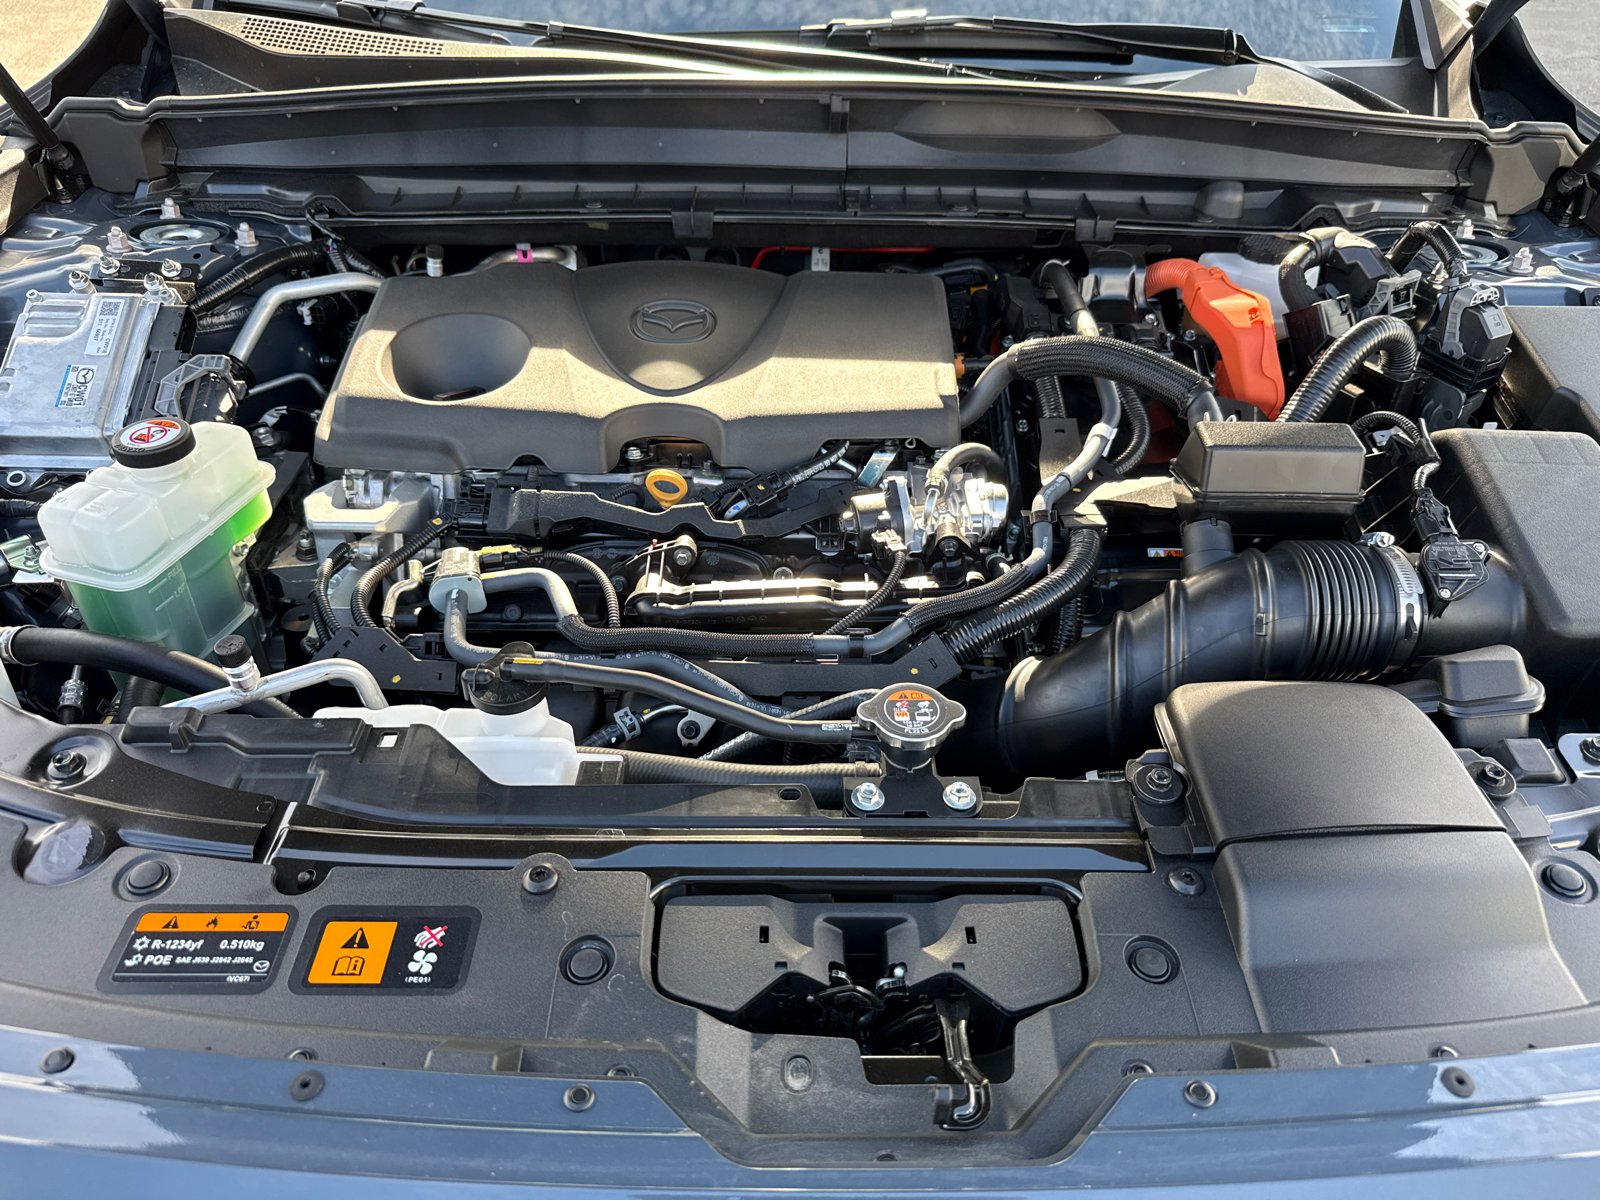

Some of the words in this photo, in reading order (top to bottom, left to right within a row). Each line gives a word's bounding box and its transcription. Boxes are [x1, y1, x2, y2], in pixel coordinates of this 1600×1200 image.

[73, 384, 88, 406] CW01
[151, 939, 204, 952] R-1234yf
[219, 939, 265, 952] 0.510kg
[144, 954, 173, 965] POE
[175, 956, 192, 964] SAE
[192, 956, 210, 964] J639
[210, 956, 231, 964] J2842
[232, 956, 254, 964] J2845
